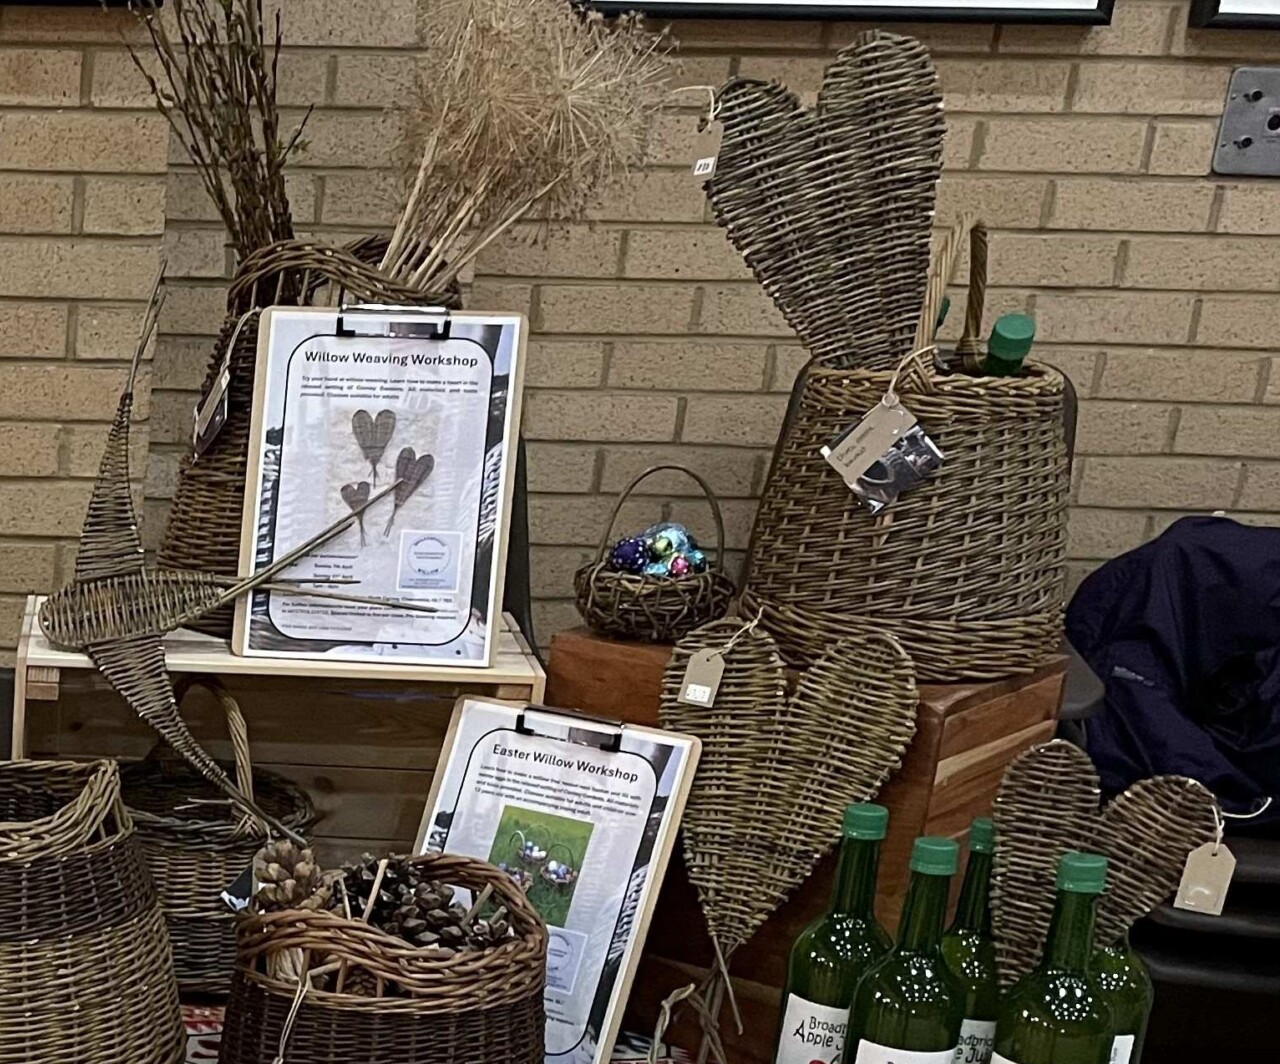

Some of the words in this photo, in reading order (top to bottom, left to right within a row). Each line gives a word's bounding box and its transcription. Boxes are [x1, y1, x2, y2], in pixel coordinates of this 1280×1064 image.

[304, 351, 350, 363] Willow
[352, 352, 408, 367] Weaving
[411, 354, 478, 368] Workshop
[492, 744, 531, 761] Easter
[533, 751, 575, 769] Willow
[576, 760, 639, 783] Workshop
[793, 1019, 833, 1048] Apple
